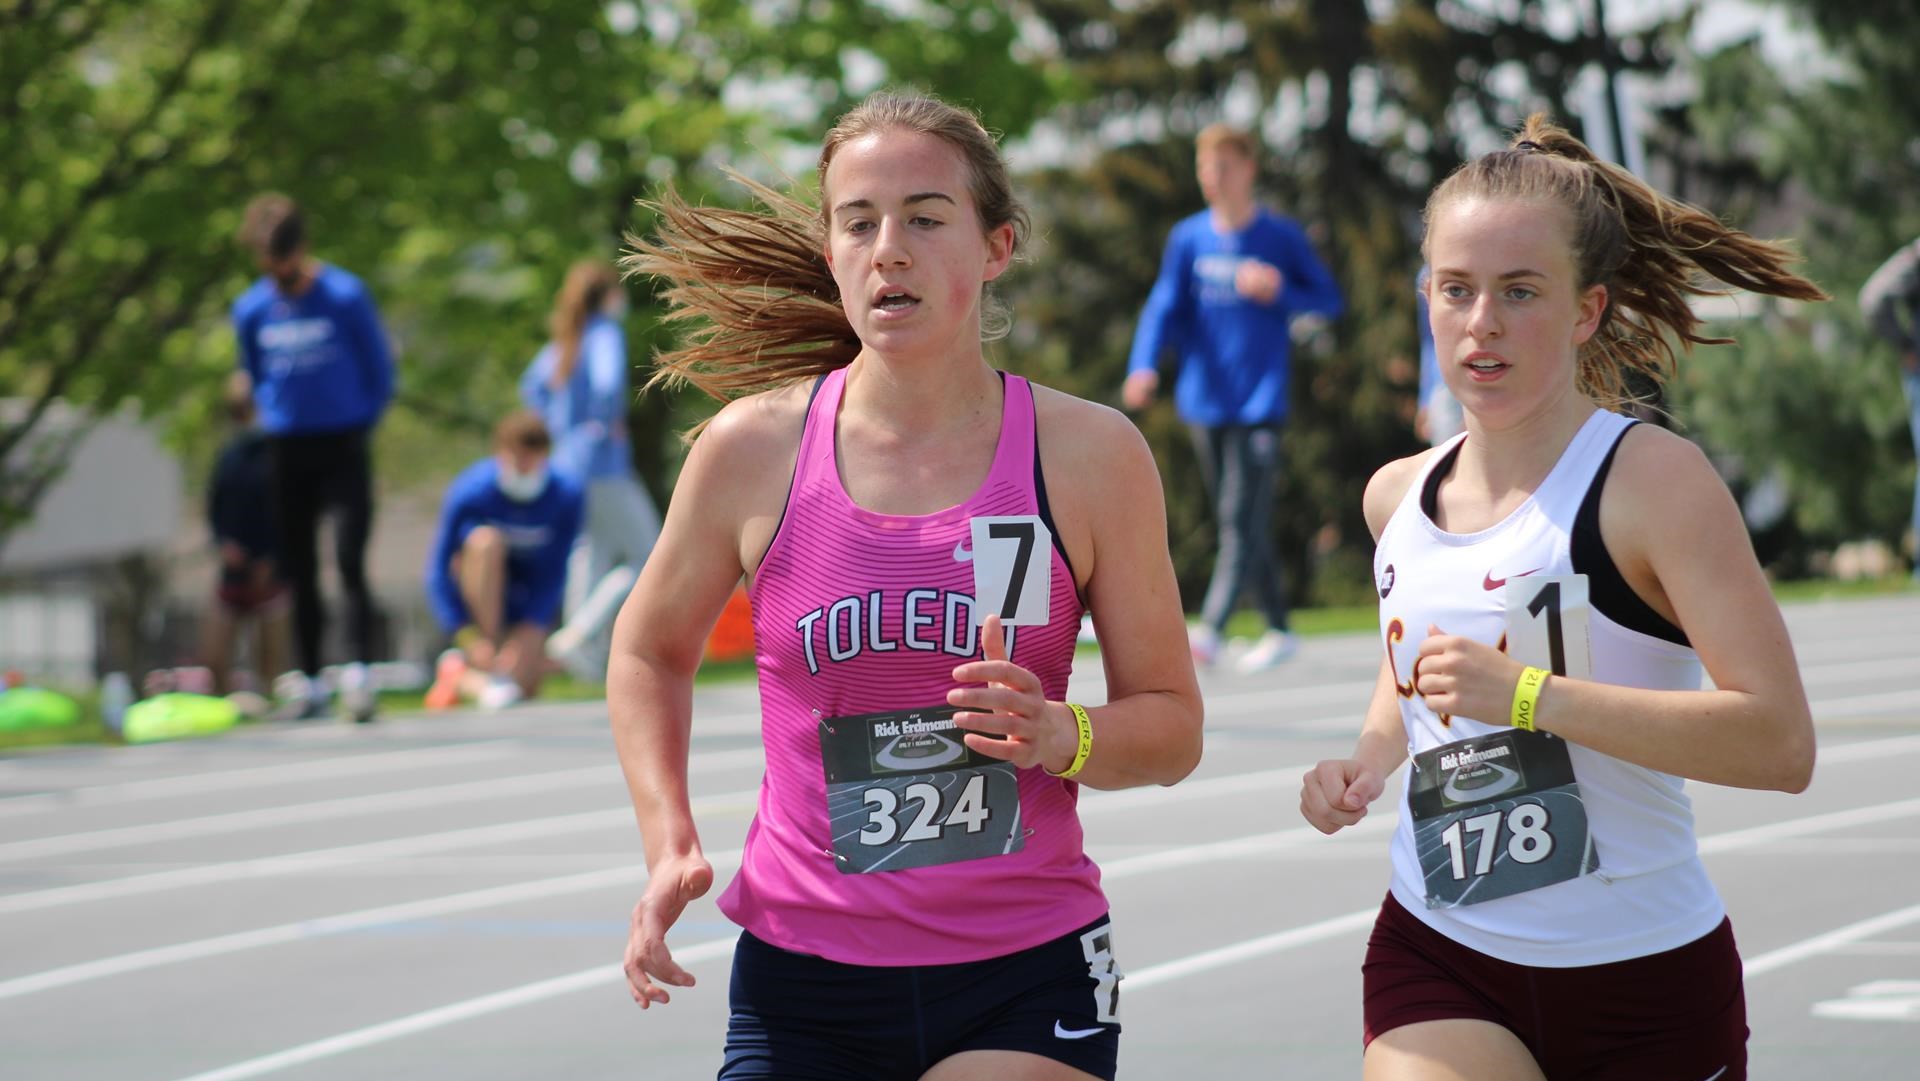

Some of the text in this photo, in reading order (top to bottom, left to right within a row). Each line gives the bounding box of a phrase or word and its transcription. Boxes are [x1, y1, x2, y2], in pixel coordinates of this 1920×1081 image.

[988, 521, 1036, 619] 7
[796, 587, 1017, 690] TOLED
[1526, 581, 1567, 678] 1
[874, 721, 900, 737] Rick
[1517, 699, 1531, 730] OVE
[1440, 745, 1511, 771] Rick Erdmann
[859, 774, 991, 848] 324
[1441, 803, 1556, 881] 178
